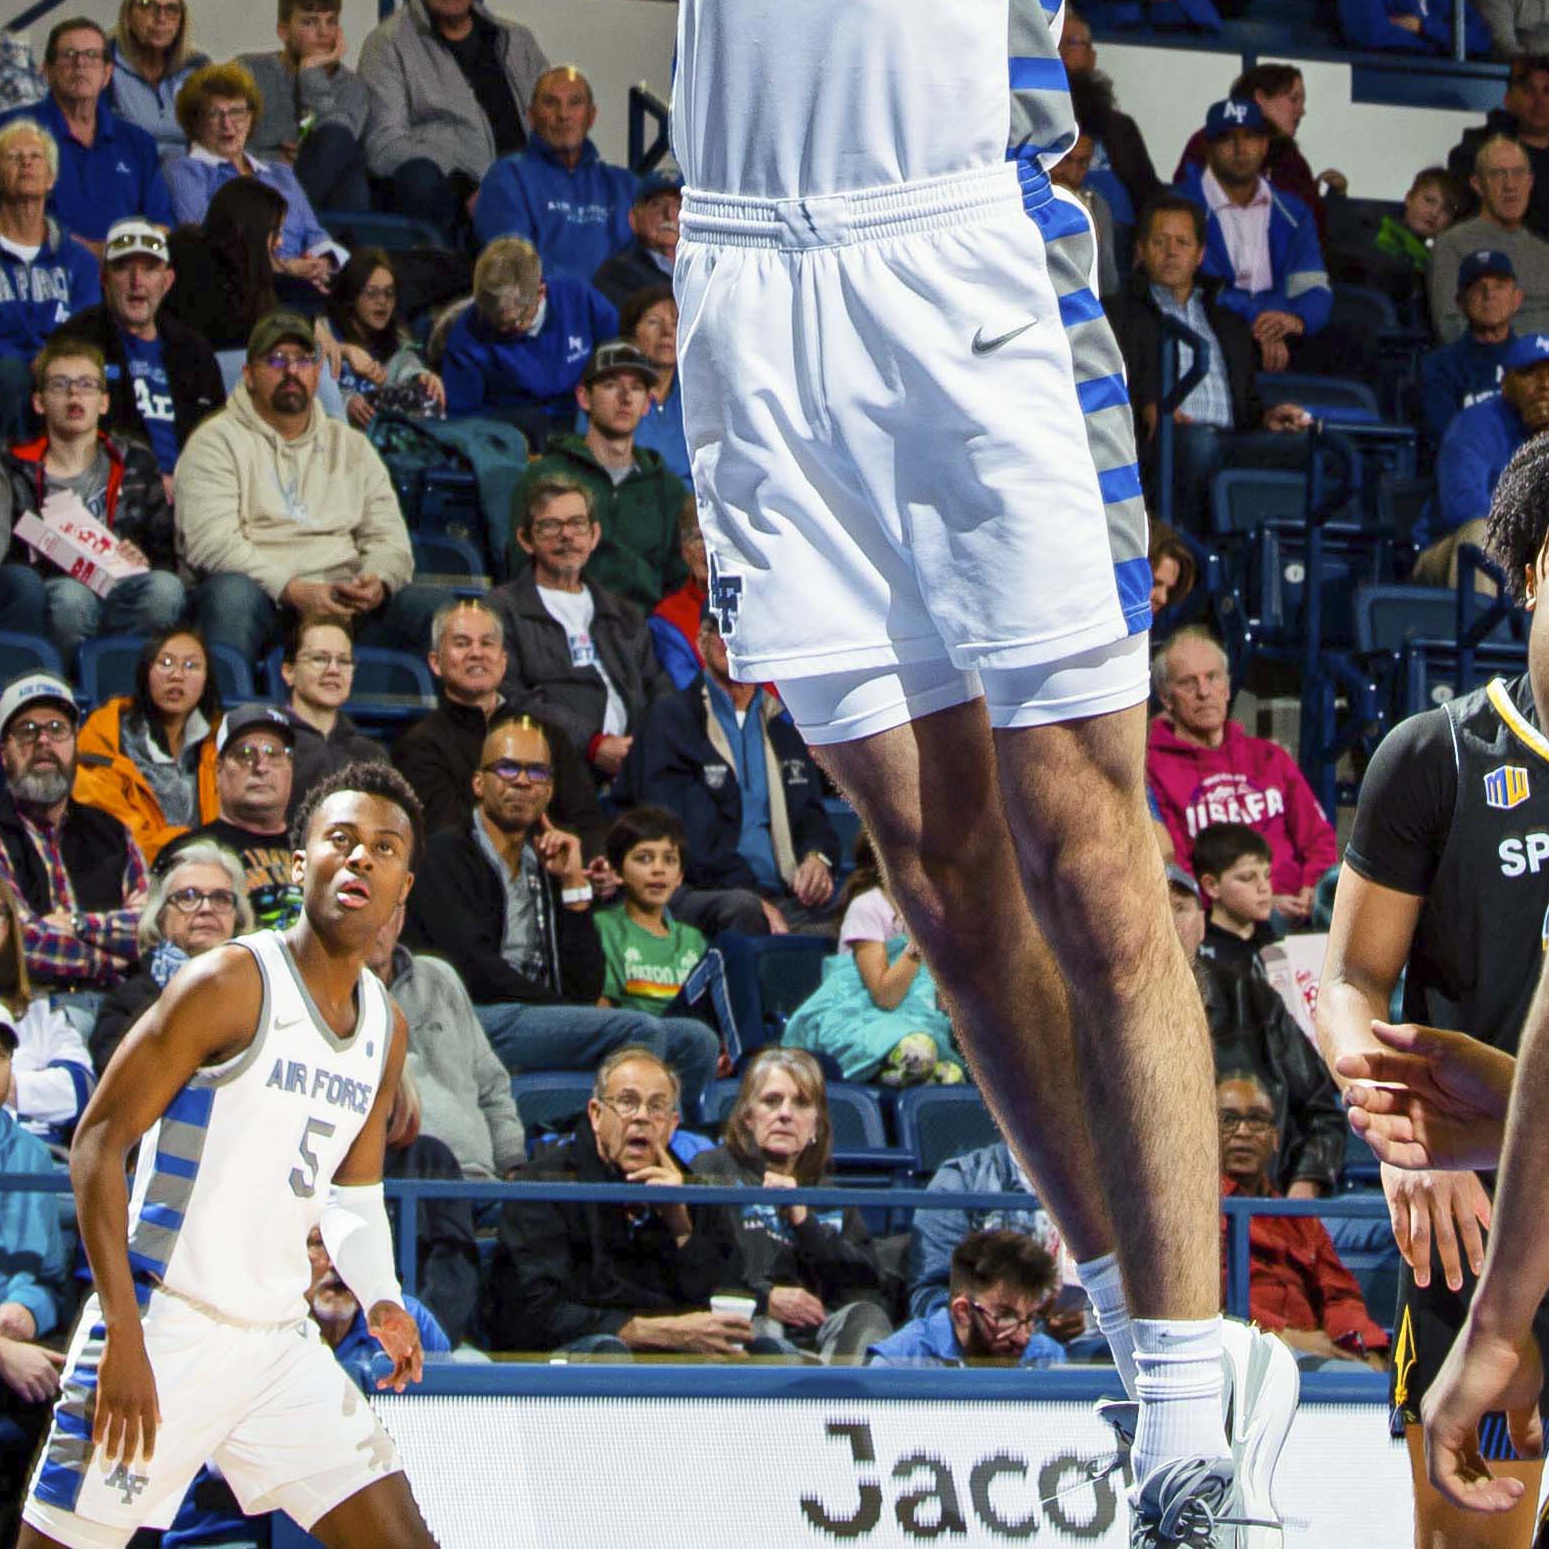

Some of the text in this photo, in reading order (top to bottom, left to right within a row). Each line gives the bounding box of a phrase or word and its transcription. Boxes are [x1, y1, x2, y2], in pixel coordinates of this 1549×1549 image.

[266, 1058, 372, 1115] AIR FORCE
[288, 1114, 336, 1199] 5
[104, 1460, 150, 1505] AF
[800, 1418, 1118, 1541] Jaco
